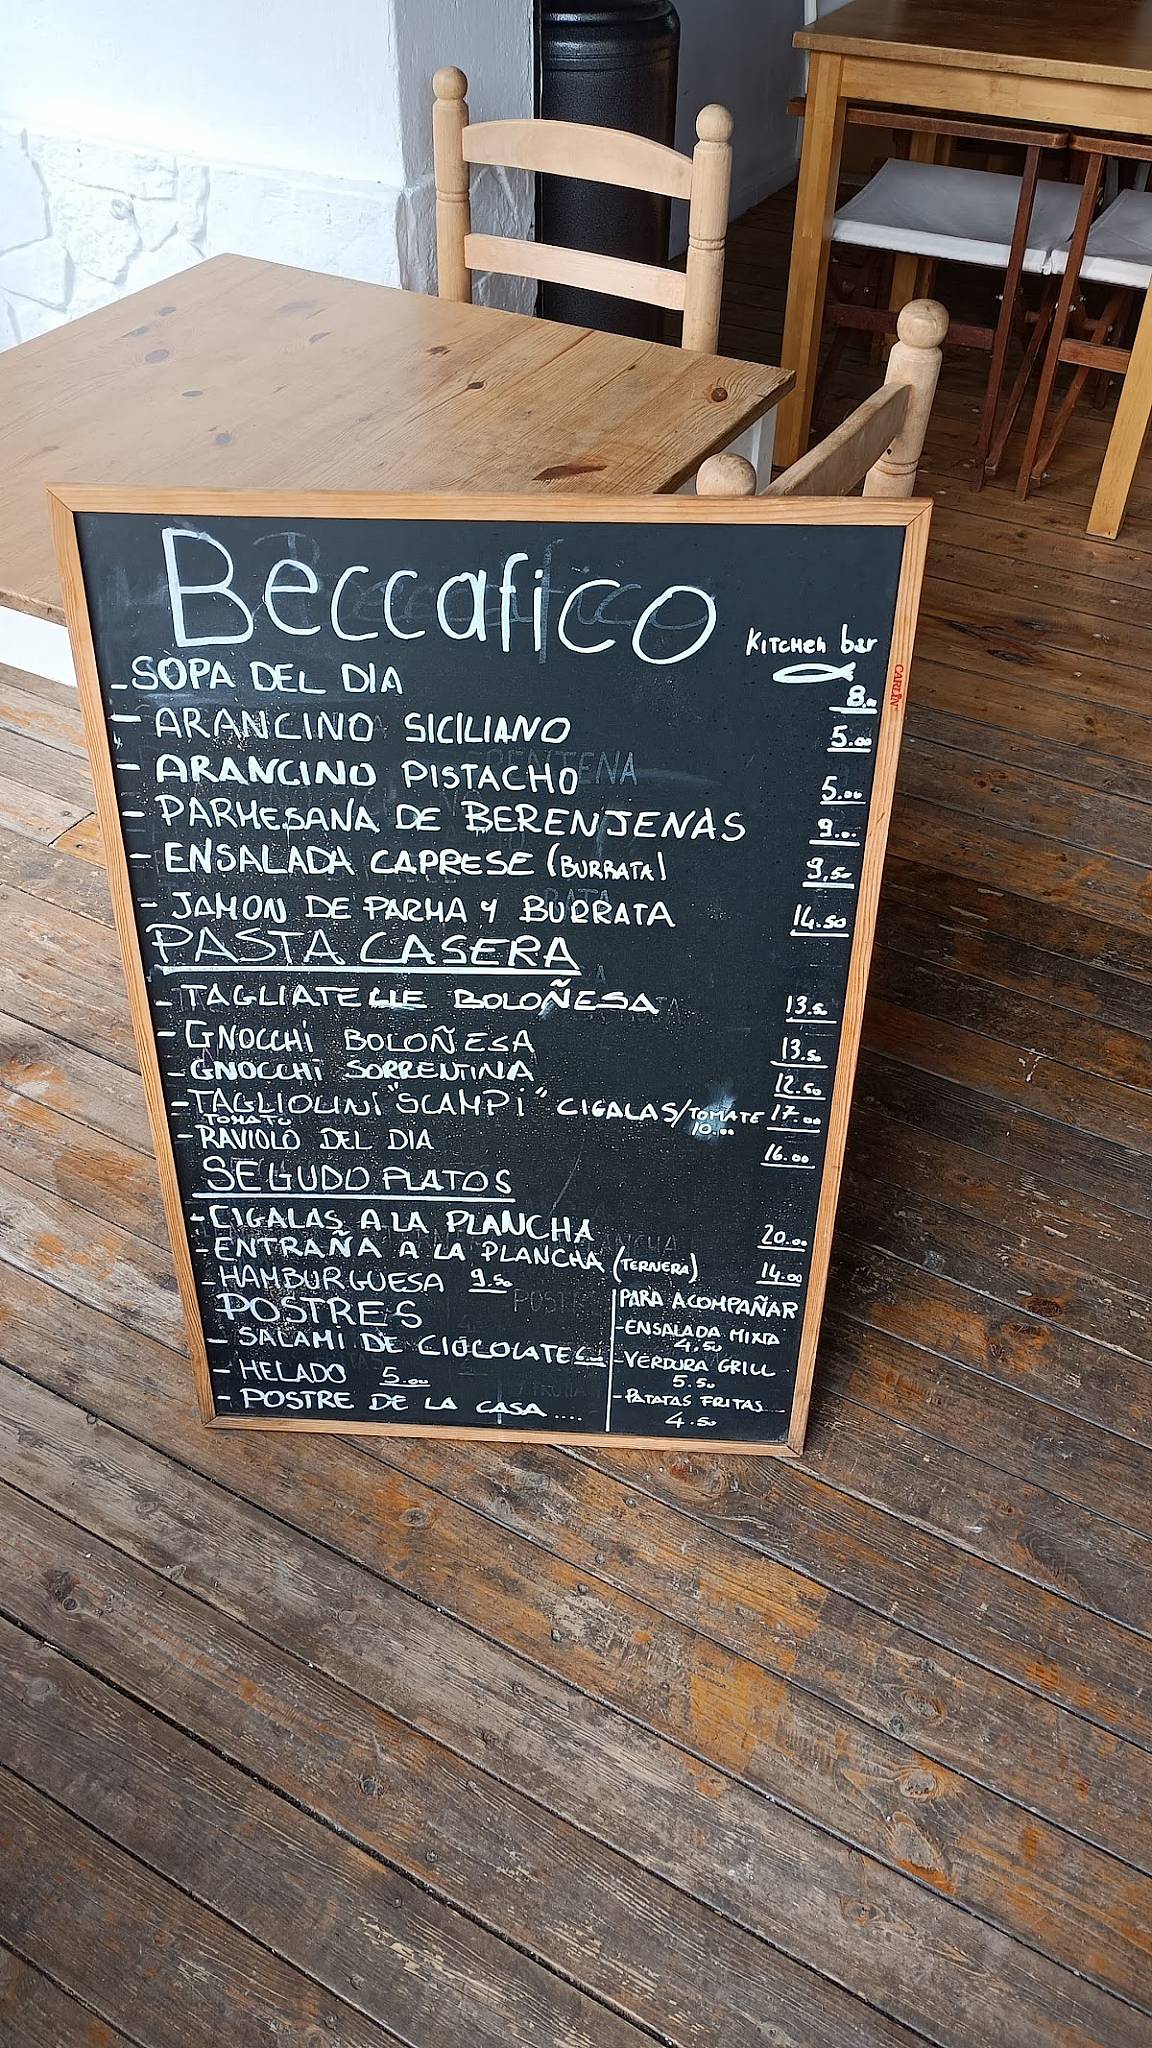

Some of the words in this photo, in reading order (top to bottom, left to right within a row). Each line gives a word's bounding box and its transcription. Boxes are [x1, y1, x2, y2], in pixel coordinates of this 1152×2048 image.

[161, 527, 717, 665] Beccafico
[131, 656, 235, 692] SOPA
[250, 662, 326, 694] DEL
[342, 663, 402, 695] DIA
[155, 707, 374, 742] ARANCINO
[403, 711, 571, 744] SICILIANO
[156, 754, 377, 786] ARANCINO
[401, 759, 578, 795] PISTACHO
[395, 803, 441, 831] DE
[461, 800, 746, 842] BERENJENAS
[164, 837, 355, 875] ENSALADA
[370, 848, 535, 876] CAPRESE
[171, 892, 287, 923] JAMON
[305, 894, 351, 919] DE
[519, 895, 676, 927] BURRATA
[793, 904, 847, 930] 14.50
[145, 923, 346, 966] PASTA
[359, 931, 581, 969] CASERA
[454, 978, 660, 1014] BOLOÑESA
[344, 1025, 536, 1054] BOLOÑESA
[345, 1059, 534, 1082] SORRENTINA
[770, 1103, 822, 1126] 17.00
[194, 1124, 300, 1150] RAVIOLO
[320, 1127, 373, 1150] DEL
[387, 1128, 434, 1150] DIA
[764, 1143, 809, 1164] 16.00
[202, 1155, 370, 1191] SEGUDO
[382, 1166, 512, 1194] PLATOS
[208, 1204, 344, 1230] CIGALAS
[360, 1208, 382, 1232] A
[391, 1211, 429, 1234] LA
[445, 1210, 595, 1244] PLANCHA
[761, 1224, 808, 1245] 20.00
[213, 1228, 382, 1262] ENTRAÑA
[399, 1240, 419, 1260] A
[433, 1241, 466, 1262] LA
[481, 1240, 606, 1273] PLANCHA
[612, 1245, 699, 1284] (TERNERA)
[761, 1261, 803, 1282] 14.00
[219, 1265, 444, 1293] HAMBURGUESA
[214, 1293, 423, 1329] POSTRES
[619, 1288, 663, 1309] PARA
[671, 1295, 799, 1319] ACOMPAÑAR
[360, 1331, 403, 1354] DE
[238, 1359, 346, 1383] HELADO
[717, 1358, 776, 1377] GRILL
[240, 1389, 354, 1410] POSTRE
[369, 1393, 409, 1411] DE
[424, 1396, 458, 1410] LA
